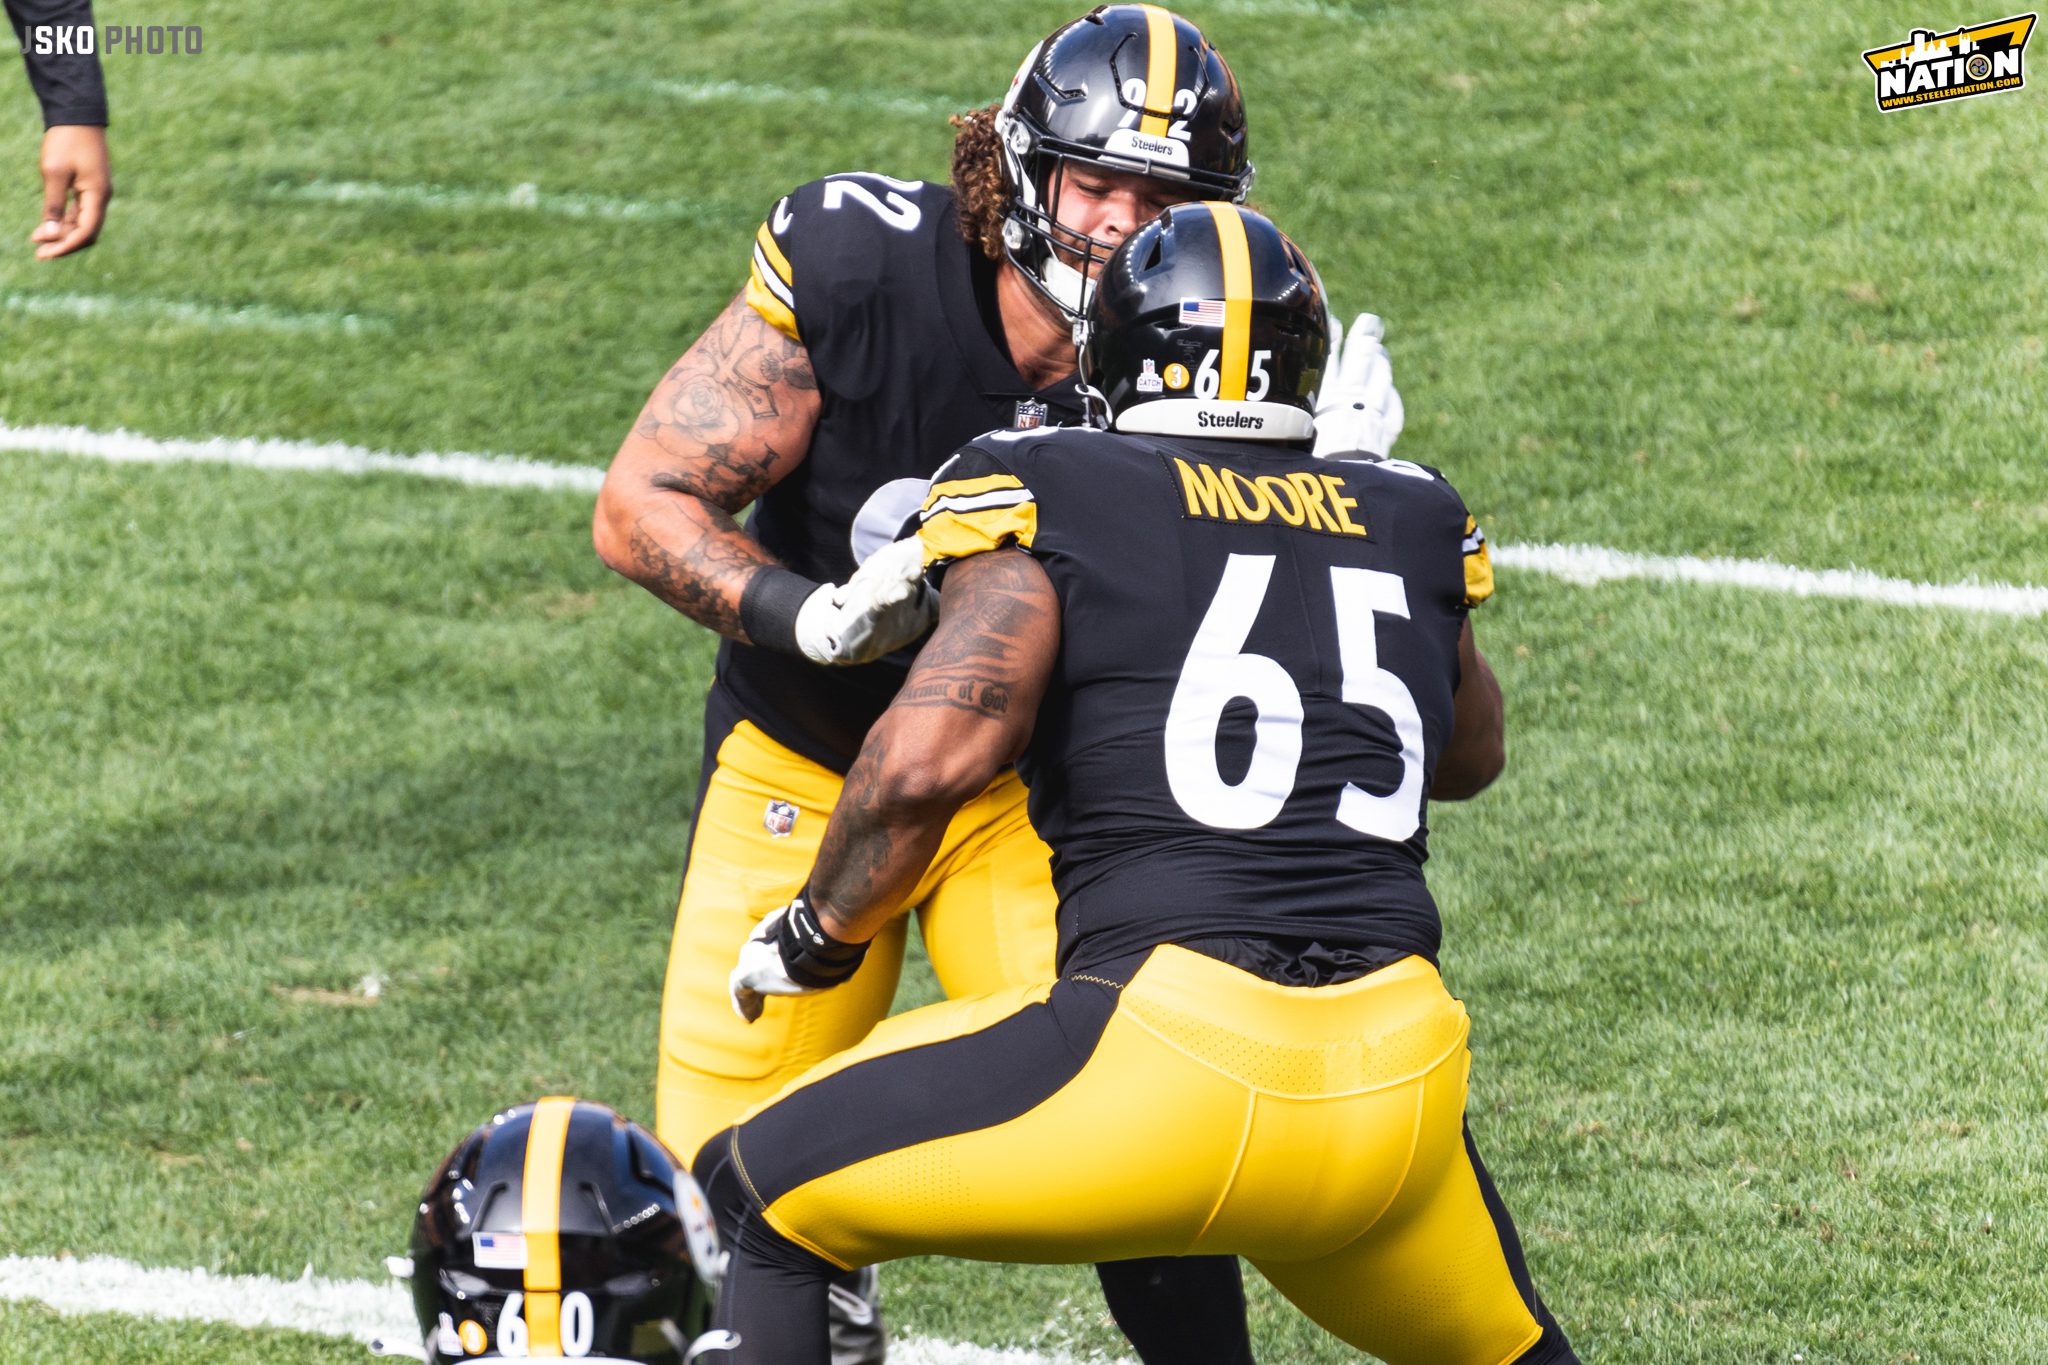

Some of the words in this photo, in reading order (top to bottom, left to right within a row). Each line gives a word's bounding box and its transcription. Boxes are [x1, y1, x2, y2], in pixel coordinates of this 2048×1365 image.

[1131, 136, 1173, 156] Steelers
[1171, 365, 1183, 387] 3
[1193, 349, 1272, 401] 65
[1198, 411, 1264, 430] Steelers
[1174, 457, 1367, 536] MOORE
[1164, 552, 1426, 842] 65
[496, 1291, 594, 1357] 60
